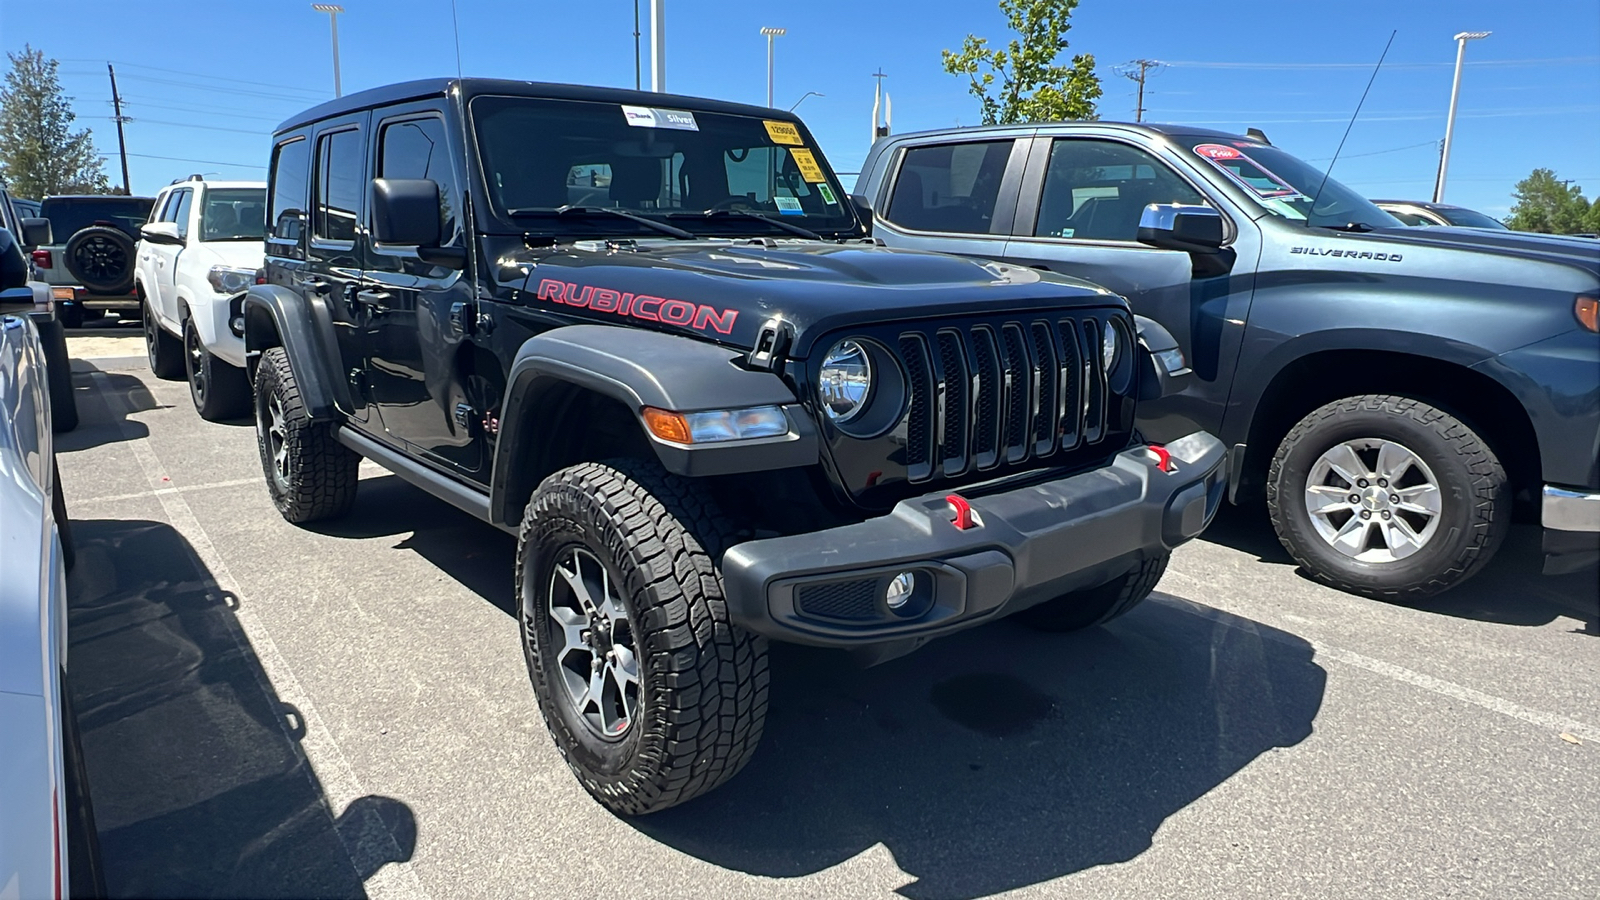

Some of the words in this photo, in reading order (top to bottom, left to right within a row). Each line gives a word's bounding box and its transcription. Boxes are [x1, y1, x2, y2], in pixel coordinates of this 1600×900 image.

[667, 114, 693, 124] Silver
[1290, 246, 1404, 262] SILVERADO
[537, 278, 740, 335] RUBICON
